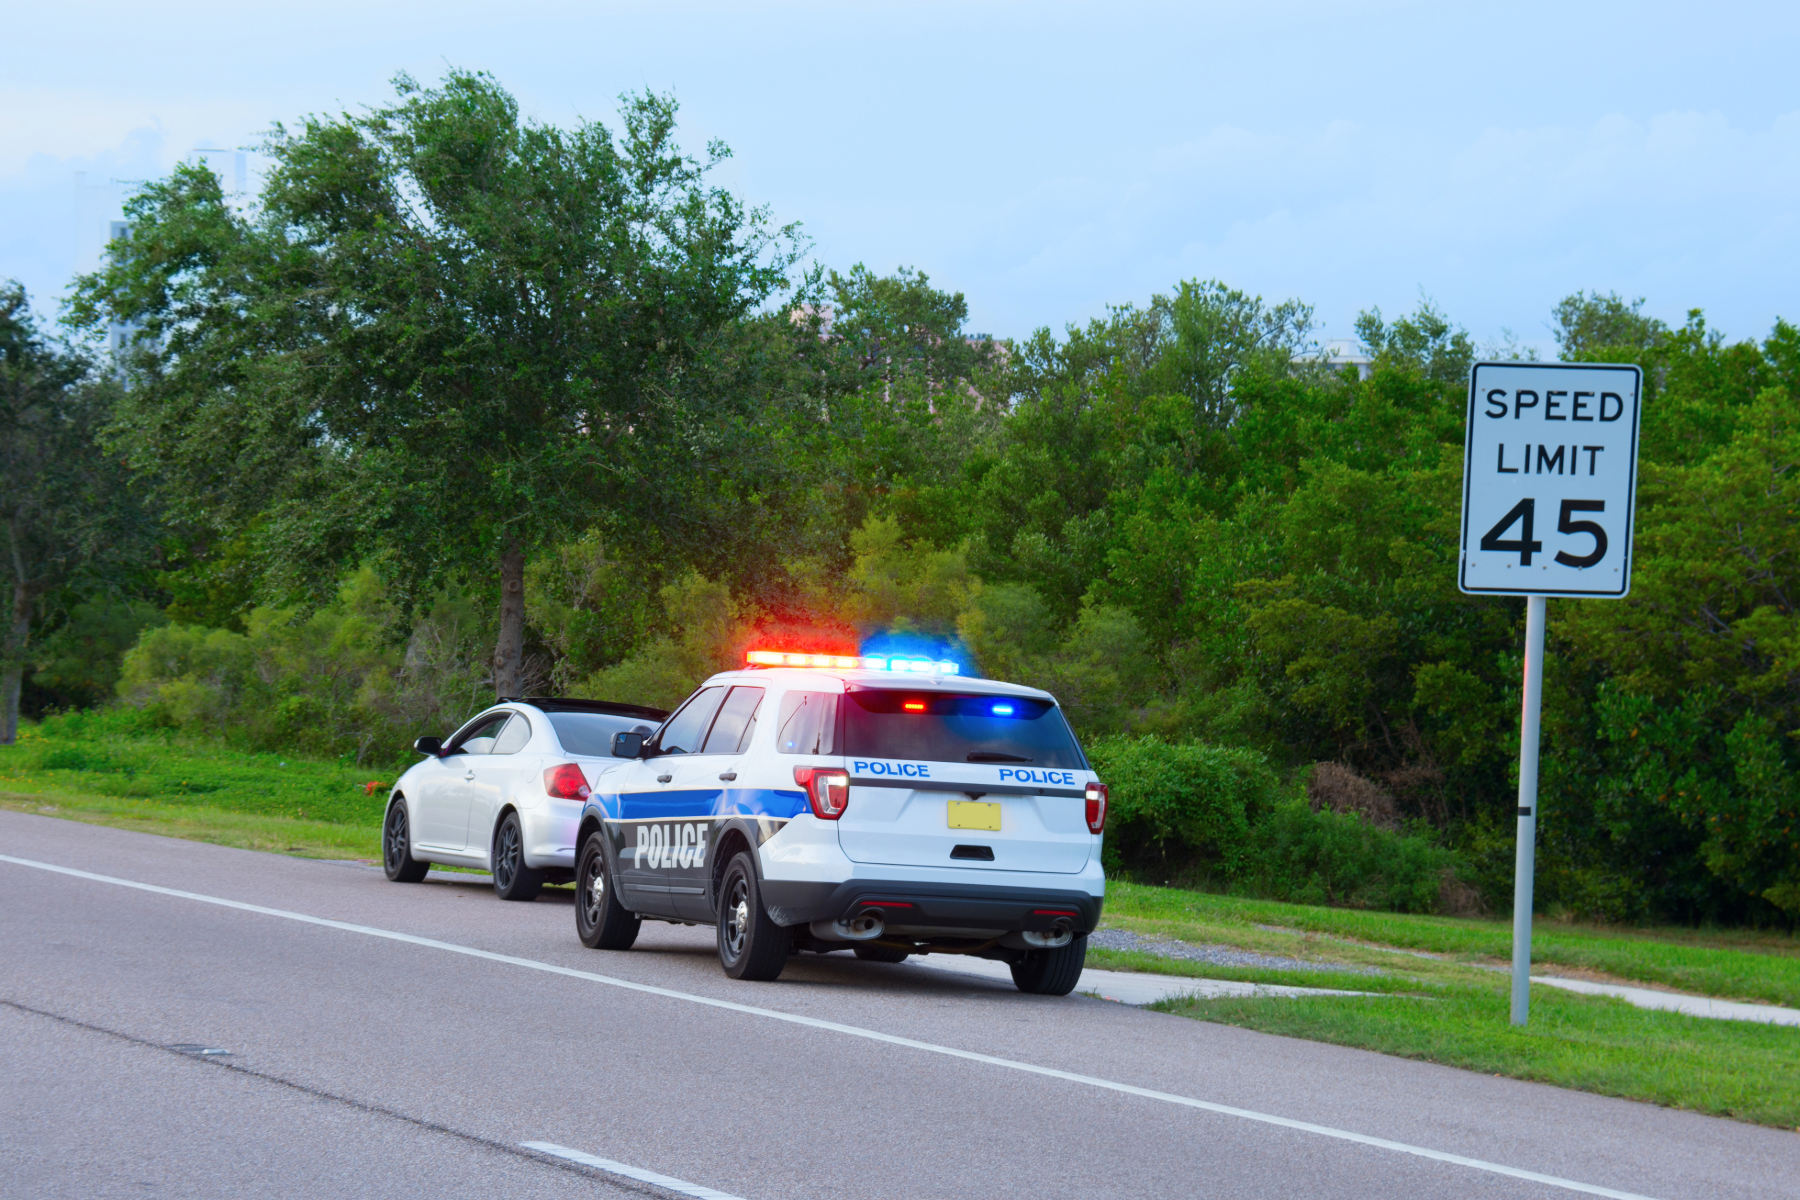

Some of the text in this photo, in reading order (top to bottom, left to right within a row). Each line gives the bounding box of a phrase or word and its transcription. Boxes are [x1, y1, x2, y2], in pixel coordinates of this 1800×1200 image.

[1484, 389, 1624, 422] SPEED
[1497, 443, 1605, 476] LIMIT
[1480, 498, 1608, 569] 45
[853, 761, 931, 778] POLICE
[999, 768, 1076, 786] POLICE
[634, 822, 709, 870] POLICE
